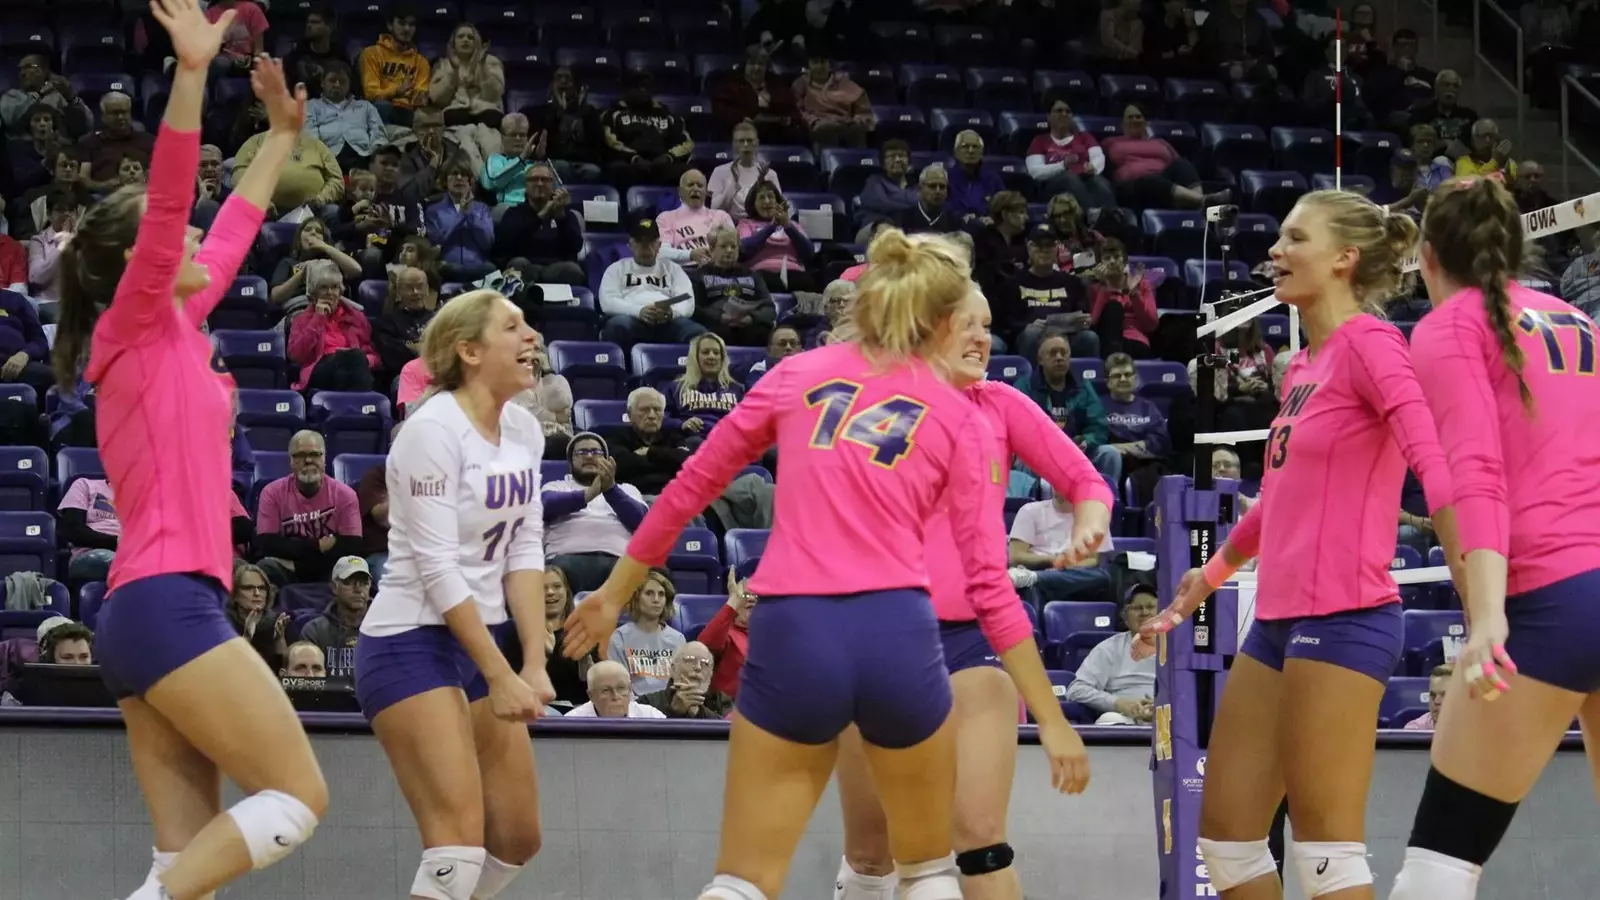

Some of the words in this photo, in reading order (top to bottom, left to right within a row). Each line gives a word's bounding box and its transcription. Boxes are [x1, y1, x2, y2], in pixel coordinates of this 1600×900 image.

[676, 225, 695, 238] YO
[1525, 206, 1559, 233] IOWA
[1515, 308, 1597, 377] 17
[803, 378, 929, 470] 14
[410, 473, 448, 497] VALLEY
[485, 467, 534, 509] UNI
